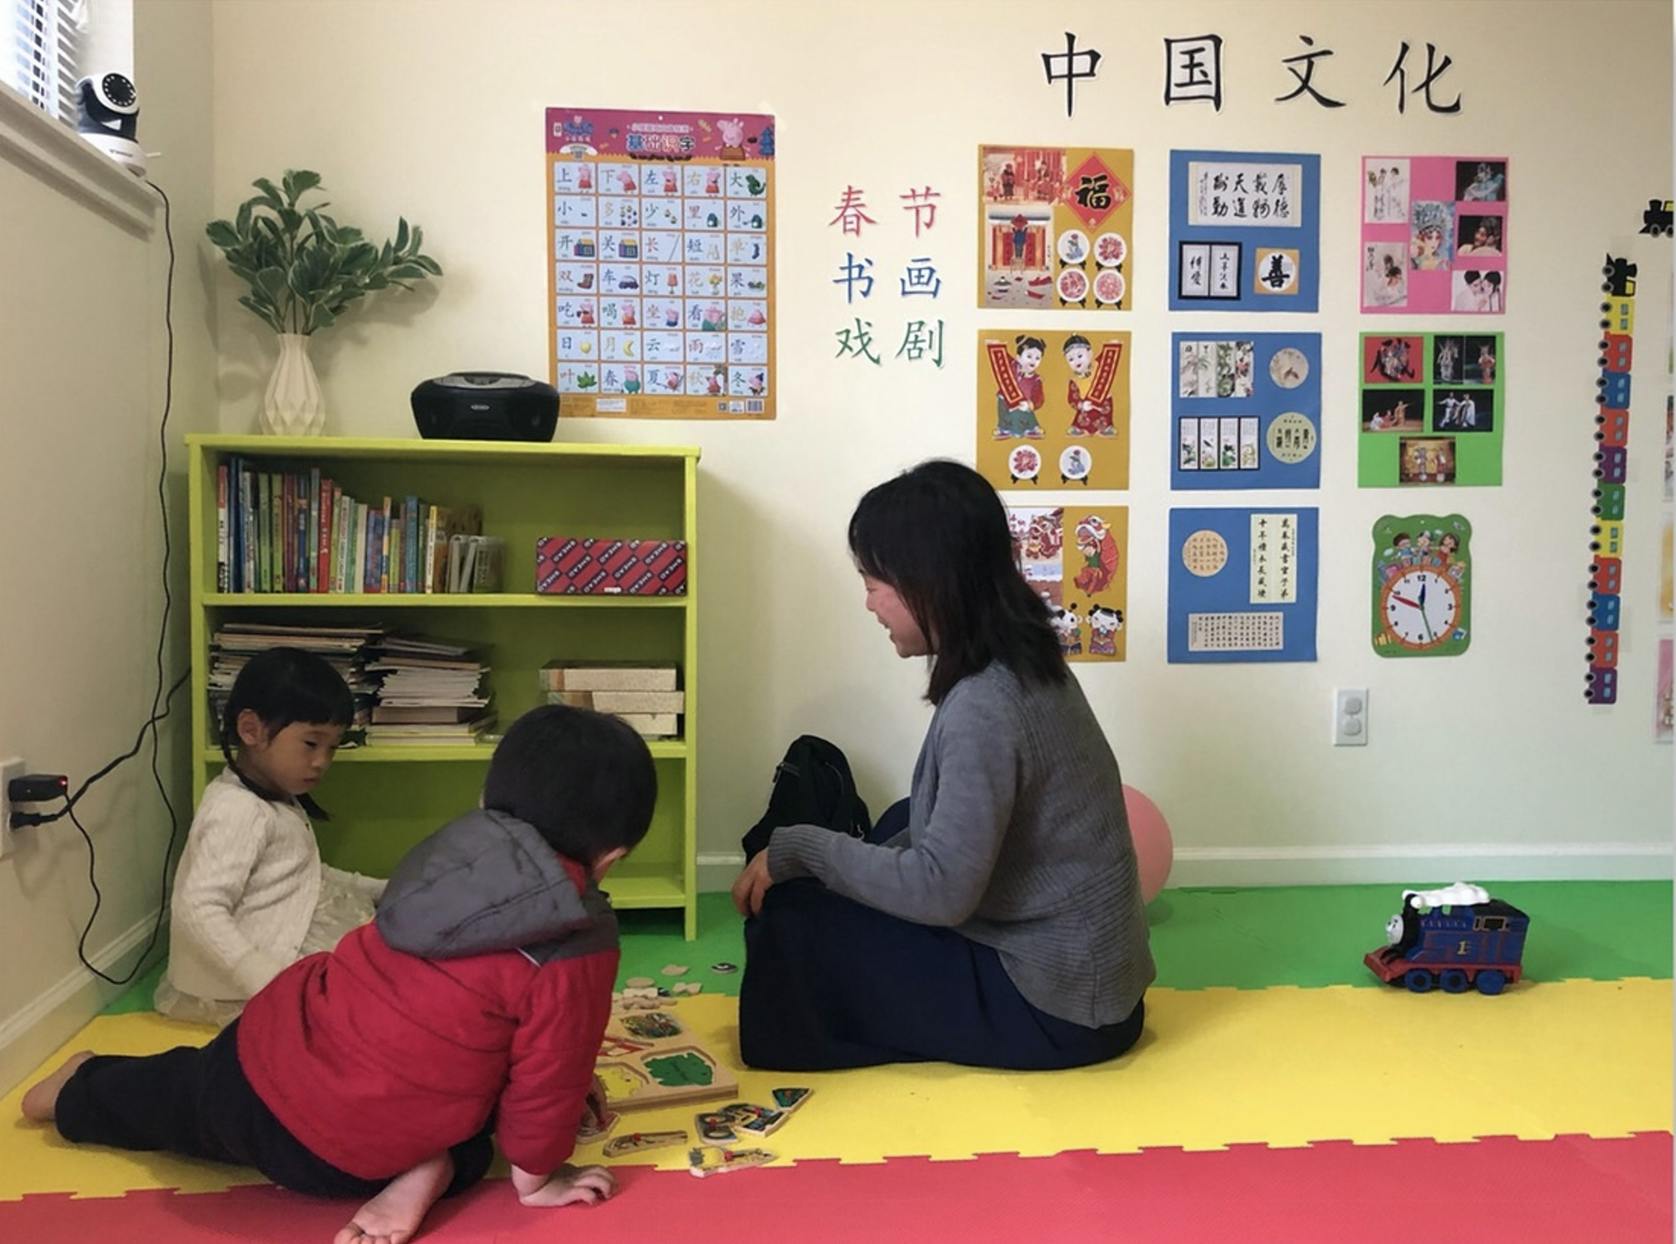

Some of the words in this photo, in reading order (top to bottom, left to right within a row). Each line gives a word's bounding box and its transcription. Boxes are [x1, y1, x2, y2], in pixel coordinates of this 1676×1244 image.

[1041, 31, 1462, 117] 中国文化
[557, 168, 572, 183] 上
[601, 169, 615, 184] 下
[644, 170, 659, 185] 左
[688, 172, 702, 186] 右
[730, 172, 743, 188] 大
[1075, 174, 1112, 210] 福
[558, 201, 572, 216] 小
[604, 202, 614, 217] 多
[645, 203, 659, 218] 少
[730, 205, 745, 222] 外
[829, 184, 942, 238] 春节
[558, 235, 573, 250] 开
[602, 235, 615, 252] 关
[645, 236, 659, 253] 长
[559, 270, 573, 282] 双
[602, 269, 616, 285] 车
[645, 270, 660, 286] 灯
[688, 272, 703, 287] 花
[832, 251, 943, 305] 书画
[1261, 254, 1291, 289] 善
[730, 272, 744, 288] 果
[558, 302, 574, 318] 吃
[602, 303, 617, 319] 喝
[646, 304, 661, 319] 坐
[688, 304, 703, 321] 看
[562, 336, 572, 350] 日
[605, 337, 615, 352] 月
[646, 338, 661, 351] 云
[688, 339, 704, 353] 雨
[731, 339, 745, 354] 雪
[834, 316, 945, 369] 戏剧
[560, 368, 575, 384] 叶
[605, 369, 618, 386] 春
[647, 369, 660, 385] 夏
[732, 371, 746, 387] 冬
[554, 541, 576, 562] SMEAD
[600, 542, 622, 563] SMEAD
[645, 543, 667, 564] SMEAD
[568, 556, 591, 577] SMEAD
[615, 557, 637, 578] SMEAD
[660, 558, 682, 579] SMEAD
[538, 570, 560, 592] SMEAD
[584, 571, 606, 593] SMEAD
[630, 573, 652, 594] SMEAD
[1457, 940, 1468, 955] 1
